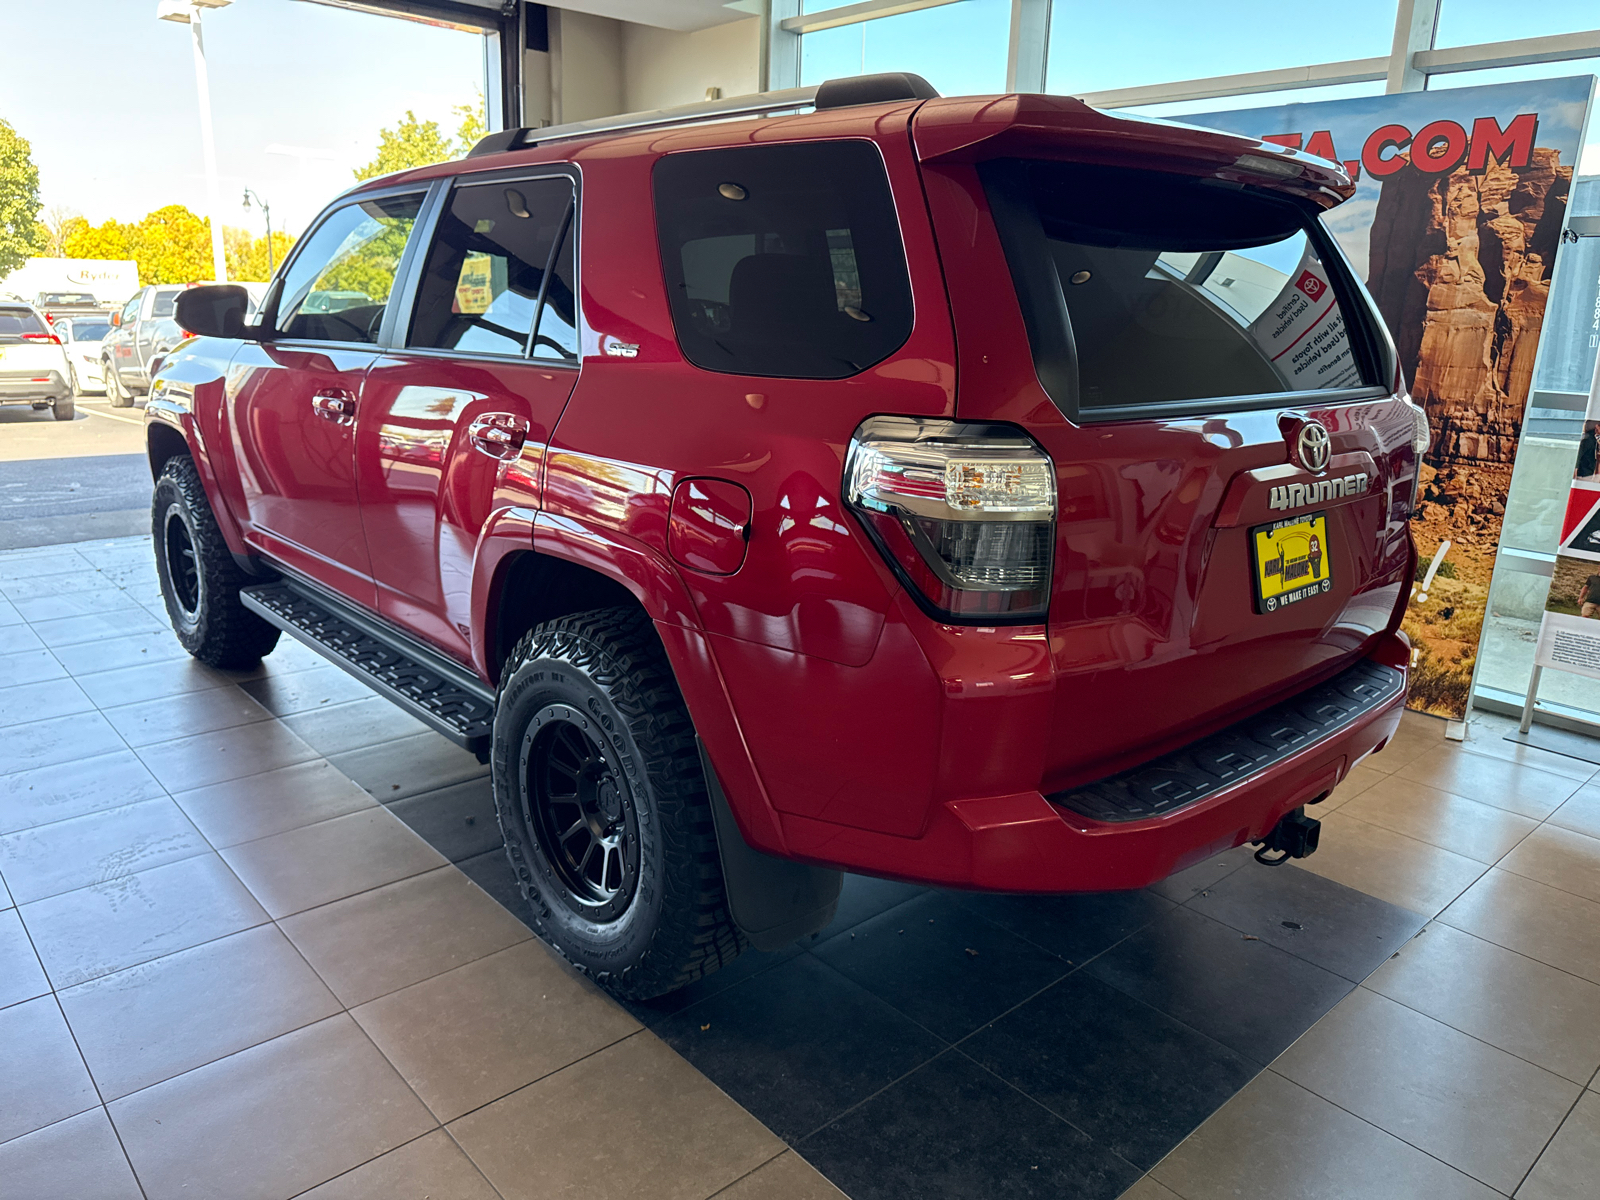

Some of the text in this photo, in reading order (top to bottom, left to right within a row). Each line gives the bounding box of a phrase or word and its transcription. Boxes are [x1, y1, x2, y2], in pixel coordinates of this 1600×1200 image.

[607, 342, 640, 358] SR5
[1269, 472, 1368, 511] 4RUNNER
[1310, 540, 1318, 552] 32
[1280, 584, 1319, 606] WE MAKE IT EASY
